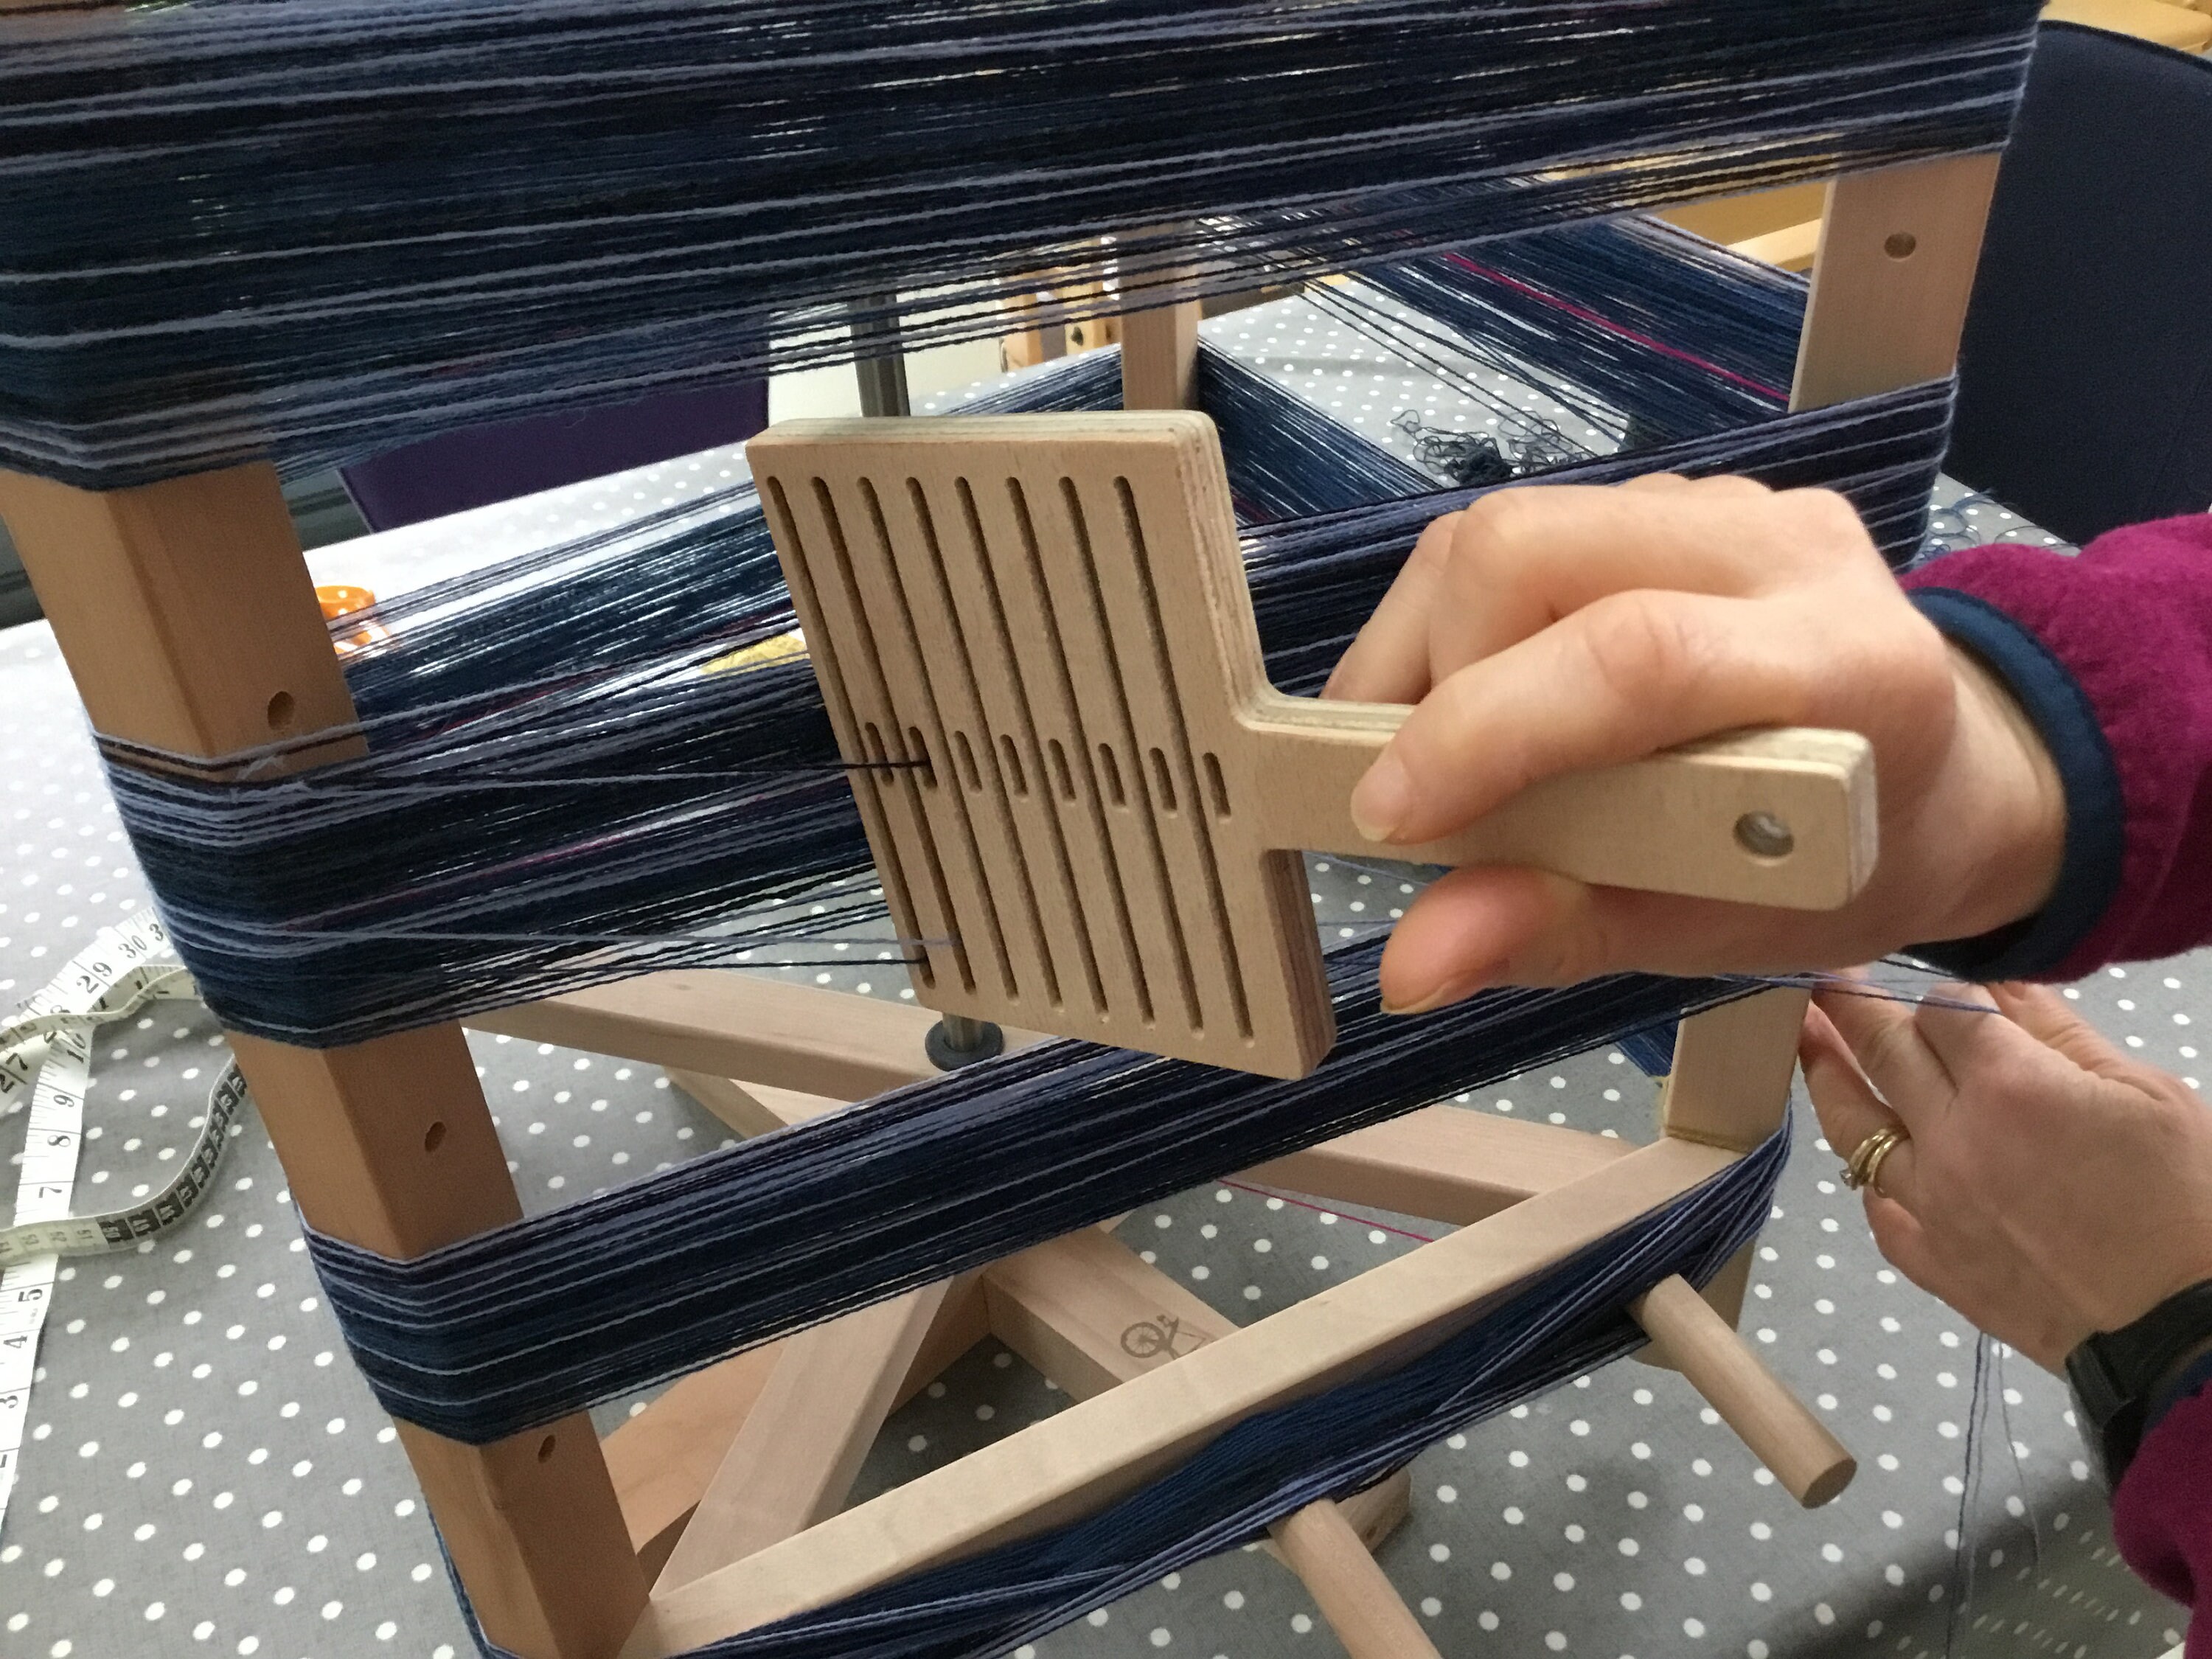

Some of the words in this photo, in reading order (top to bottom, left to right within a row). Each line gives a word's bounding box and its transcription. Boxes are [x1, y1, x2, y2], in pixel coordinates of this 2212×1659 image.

[76, 961, 112, 994] 29
[118, 935, 147, 959] 30
[53, 1094, 74, 1108] 9
[47, 1135, 72, 1147] 8
[38, 1186, 63, 1199] 7
[18, 1288, 43, 1302] 5
[3, 1335, 28, 1349] 4
